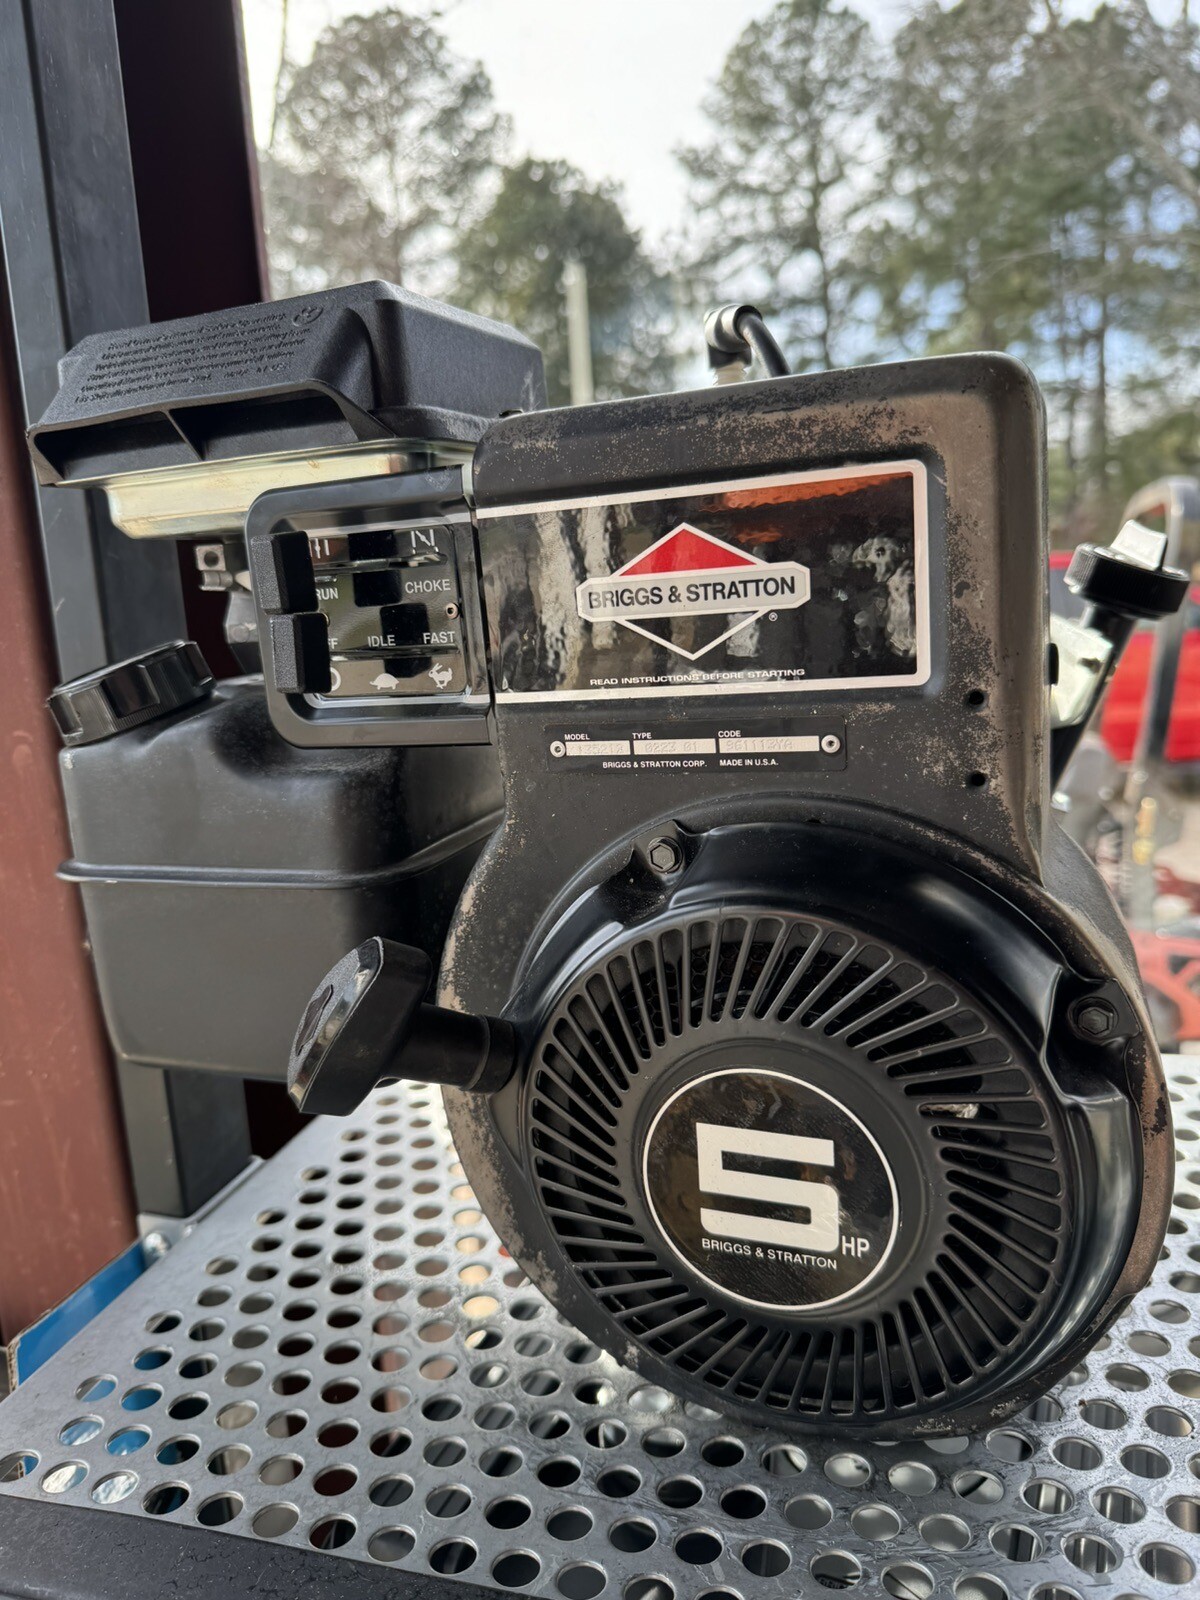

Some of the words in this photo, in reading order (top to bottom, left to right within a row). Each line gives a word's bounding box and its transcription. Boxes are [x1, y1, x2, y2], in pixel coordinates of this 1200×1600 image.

[315, 587, 339, 601] RUN
[404, 579, 452, 595] CHOKE
[588, 586, 663, 609] BRIGGS
[668, 585, 682, 603] &
[686, 576, 796, 603] STRATTON
[367, 635, 397, 648] IDLE
[422, 631, 456, 645] FAST
[589, 678, 618, 686] READ
[621, 673, 700, 684] INSTRUCTIONS
[702, 672, 745, 681] BEFORE
[747, 669, 805, 679] STARTING
[564, 733, 591, 741] MODEL
[632, 732, 652, 740] TYPE
[718, 730, 742, 738] CODE
[602, 761, 632, 769] BRIGGS
[640, 760, 681, 768] STRATTON
[683, 760, 708, 768] CORP.
[720, 759, 743, 767] MADE
[754, 758, 779, 766] U.S.A.
[696, 1122, 840, 1253] 5
[841, 1235, 870, 1258] HP
[701, 1237, 752, 1256] BRIGGS
[755, 1247, 765, 1258] &
[767, 1249, 838, 1270] STRATTON
